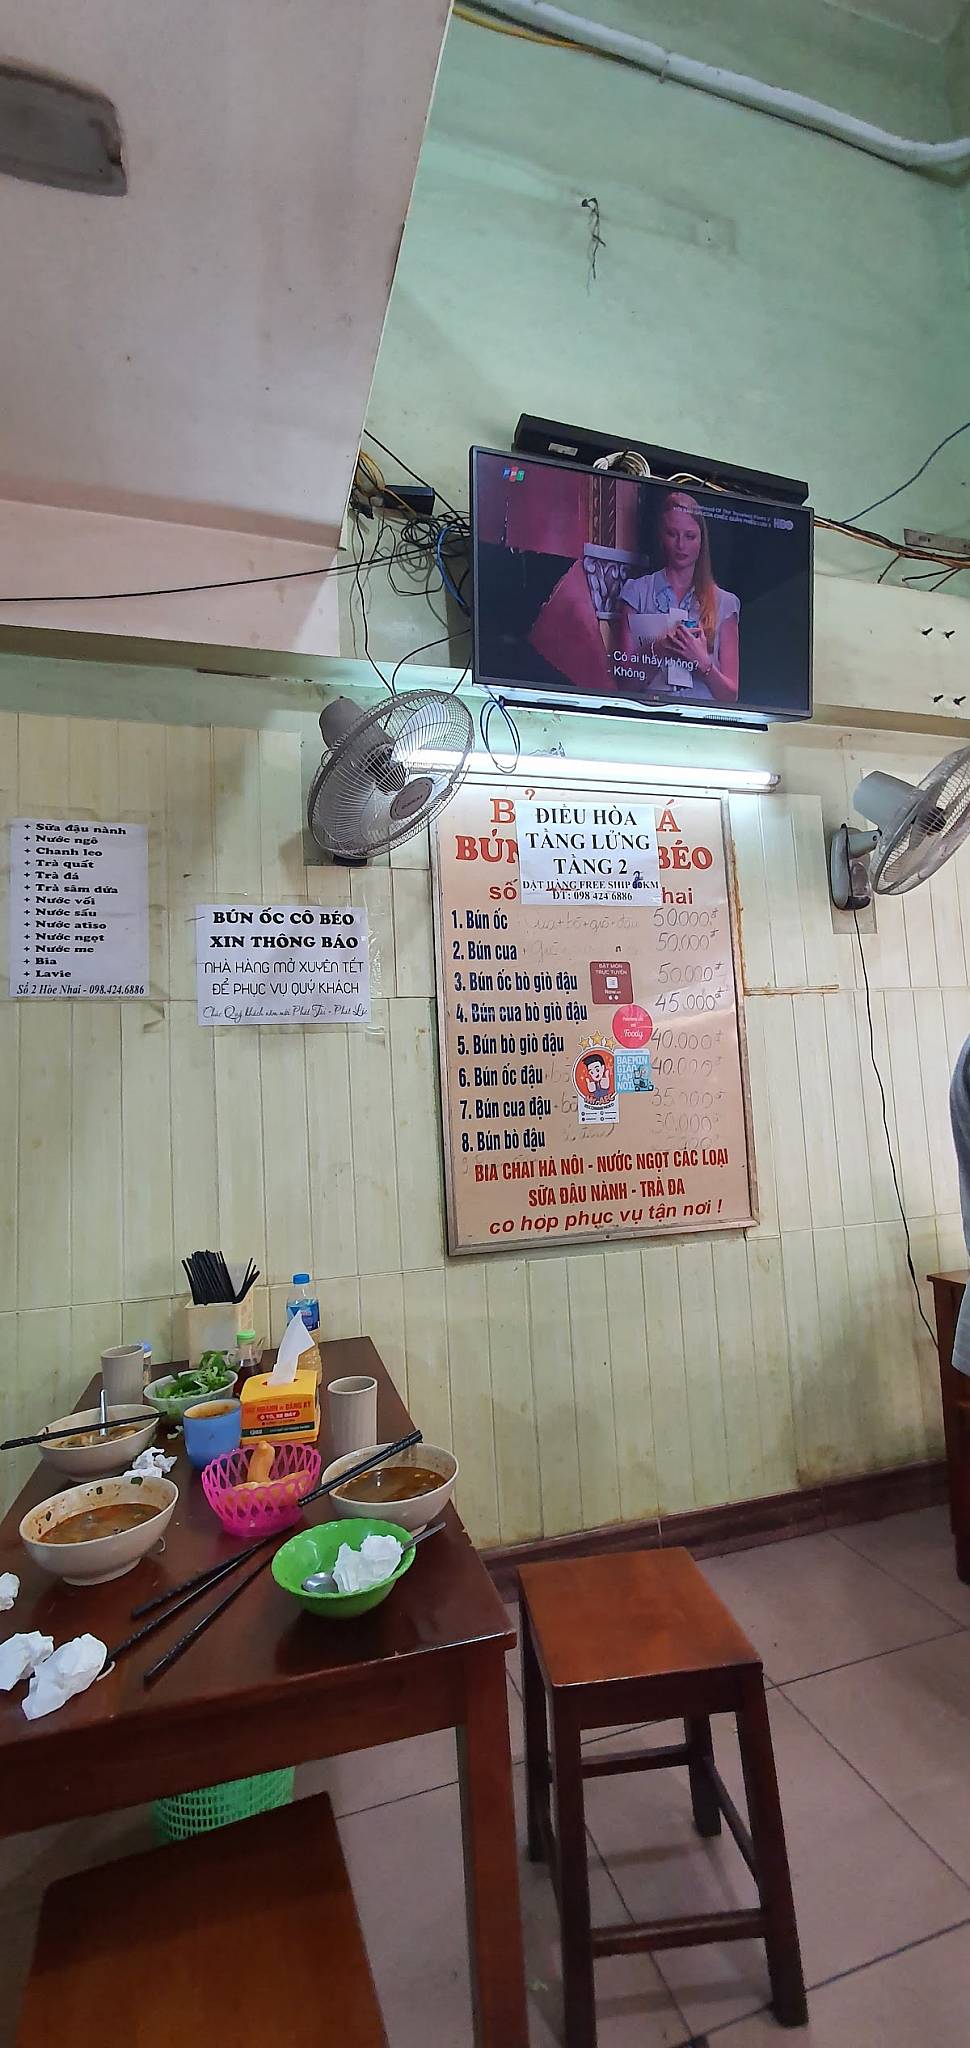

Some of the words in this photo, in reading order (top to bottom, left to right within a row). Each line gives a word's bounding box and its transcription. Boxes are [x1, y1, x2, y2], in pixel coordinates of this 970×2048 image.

[773, 518, 794, 530] HBO
[613, 651, 627, 661] Có
[642, 654, 663, 667] thấy
[665, 657, 699, 671] không?
[594, 805, 637, 826] HÒA
[65, 825, 88, 833] đậu
[36, 835, 70, 843] Nước
[74, 837, 98, 845] ngô
[526, 828, 586, 849] TẦNG
[36, 847, 79, 855] Chanh
[63, 860, 94, 869] quất
[553, 854, 612, 875] TẦNG
[618, 859, 628, 874] 2
[64, 872, 79, 880] đá
[546, 878, 577, 889] HÀNG
[579, 881, 605, 889] FREE
[608, 881, 631, 889] SHIP
[489, 879, 517, 900] số
[574, 891, 590, 900] 098
[593, 892, 608, 900] 424
[612, 892, 632, 901] 6886
[36, 896, 70, 904] Nước
[75, 897, 95, 905] vối
[36, 908, 70, 916] Nước
[75, 908, 96, 916] sấu
[213, 909, 253, 924] BÚN
[260, 907, 284, 924] ỐC
[290, 910, 314, 925] CÔ
[320, 911, 354, 925] BÉO
[452, 910, 463, 928] 1.
[466, 910, 489, 929] Bún
[494, 908, 508, 929] ốc
[36, 920, 70, 928] Nước
[36, 933, 70, 941] Nước
[75, 935, 105, 943] ngọt
[210, 936, 244, 948] XIN
[250, 933, 316, 948] THÔNG
[322, 934, 358, 948] BÁO
[36, 945, 70, 953] Nước
[453, 941, 464, 960] 2.
[468, 941, 491, 960] Bún
[495, 944, 517, 960] cua
[36, 957, 57, 965] Bia
[342, 957, 364, 973] TẾT
[17, 982, 29, 994] Số
[31, 985, 36, 994] 2
[39, 985, 57, 994] Hòe
[60, 984, 81, 994] Nhai
[89, 984, 144, 995] 098.424.6886
[212, 978, 229, 995] ĐỂ
[234, 983, 266, 997] PHỤC
[270, 983, 288, 997] VỤ
[292, 979, 315, 996] QUÝ
[318, 980, 359, 994] KHÁCH
[454, 972, 466, 991] 3.
[469, 972, 493, 991] Bún
[497, 969, 512, 991] ốc
[516, 972, 530, 990] bò
[534, 972, 552, 993] giò
[556, 972, 577, 994] đậu
[456, 1004, 468, 1022] 4.
[472, 1003, 495, 1022] Bún
[500, 1006, 521, 1022] cua
[525, 1003, 539, 1021] bò
[544, 1002, 562, 1023] giò
[566, 1002, 587, 1024] đậu
[624, 1029, 643, 1040] Foody
[458, 1036, 469, 1055] 5.
[474, 1034, 496, 1054] Bún
[501, 1034, 515, 1054] bò
[520, 1034, 538, 1055] giò
[542, 1033, 564, 1056] đậu
[617, 1056, 647, 1064] BAEMIN
[459, 1068, 470, 1087] 6.
[475, 1066, 497, 1086] Bún
[502, 1063, 516, 1085] ốc
[521, 1065, 542, 1088] đậu
[460, 1100, 471, 1119] 7.
[476, 1098, 499, 1118] Bún
[504, 1100, 525, 1117] cua
[529, 1096, 551, 1120] đậu
[462, 1133, 473, 1152] 8.
[477, 1131, 500, 1151] Bún
[505, 1129, 519, 1149] bò
[524, 1128, 545, 1152] đậu
[475, 1164, 498, 1182] BIA
[503, 1161, 534, 1180] CHAI
[539, 1156, 557, 1176] HÀ
[597, 1150, 632, 1173] NƯỚC
[637, 1151, 669, 1172] NGỌT
[674, 1147, 698, 1167] CÁC
[702, 1148, 729, 1168] LOẠI
[528, 1184, 556, 1206] SỮA
[591, 1181, 627, 1202] NÀNH
[640, 1176, 665, 1198] TRÀ
[565, 1211, 614, 1231] phục
[620, 1208, 643, 1225] vụ
[648, 1202, 677, 1222] tận
[683, 1199, 711, 1216] nơi
